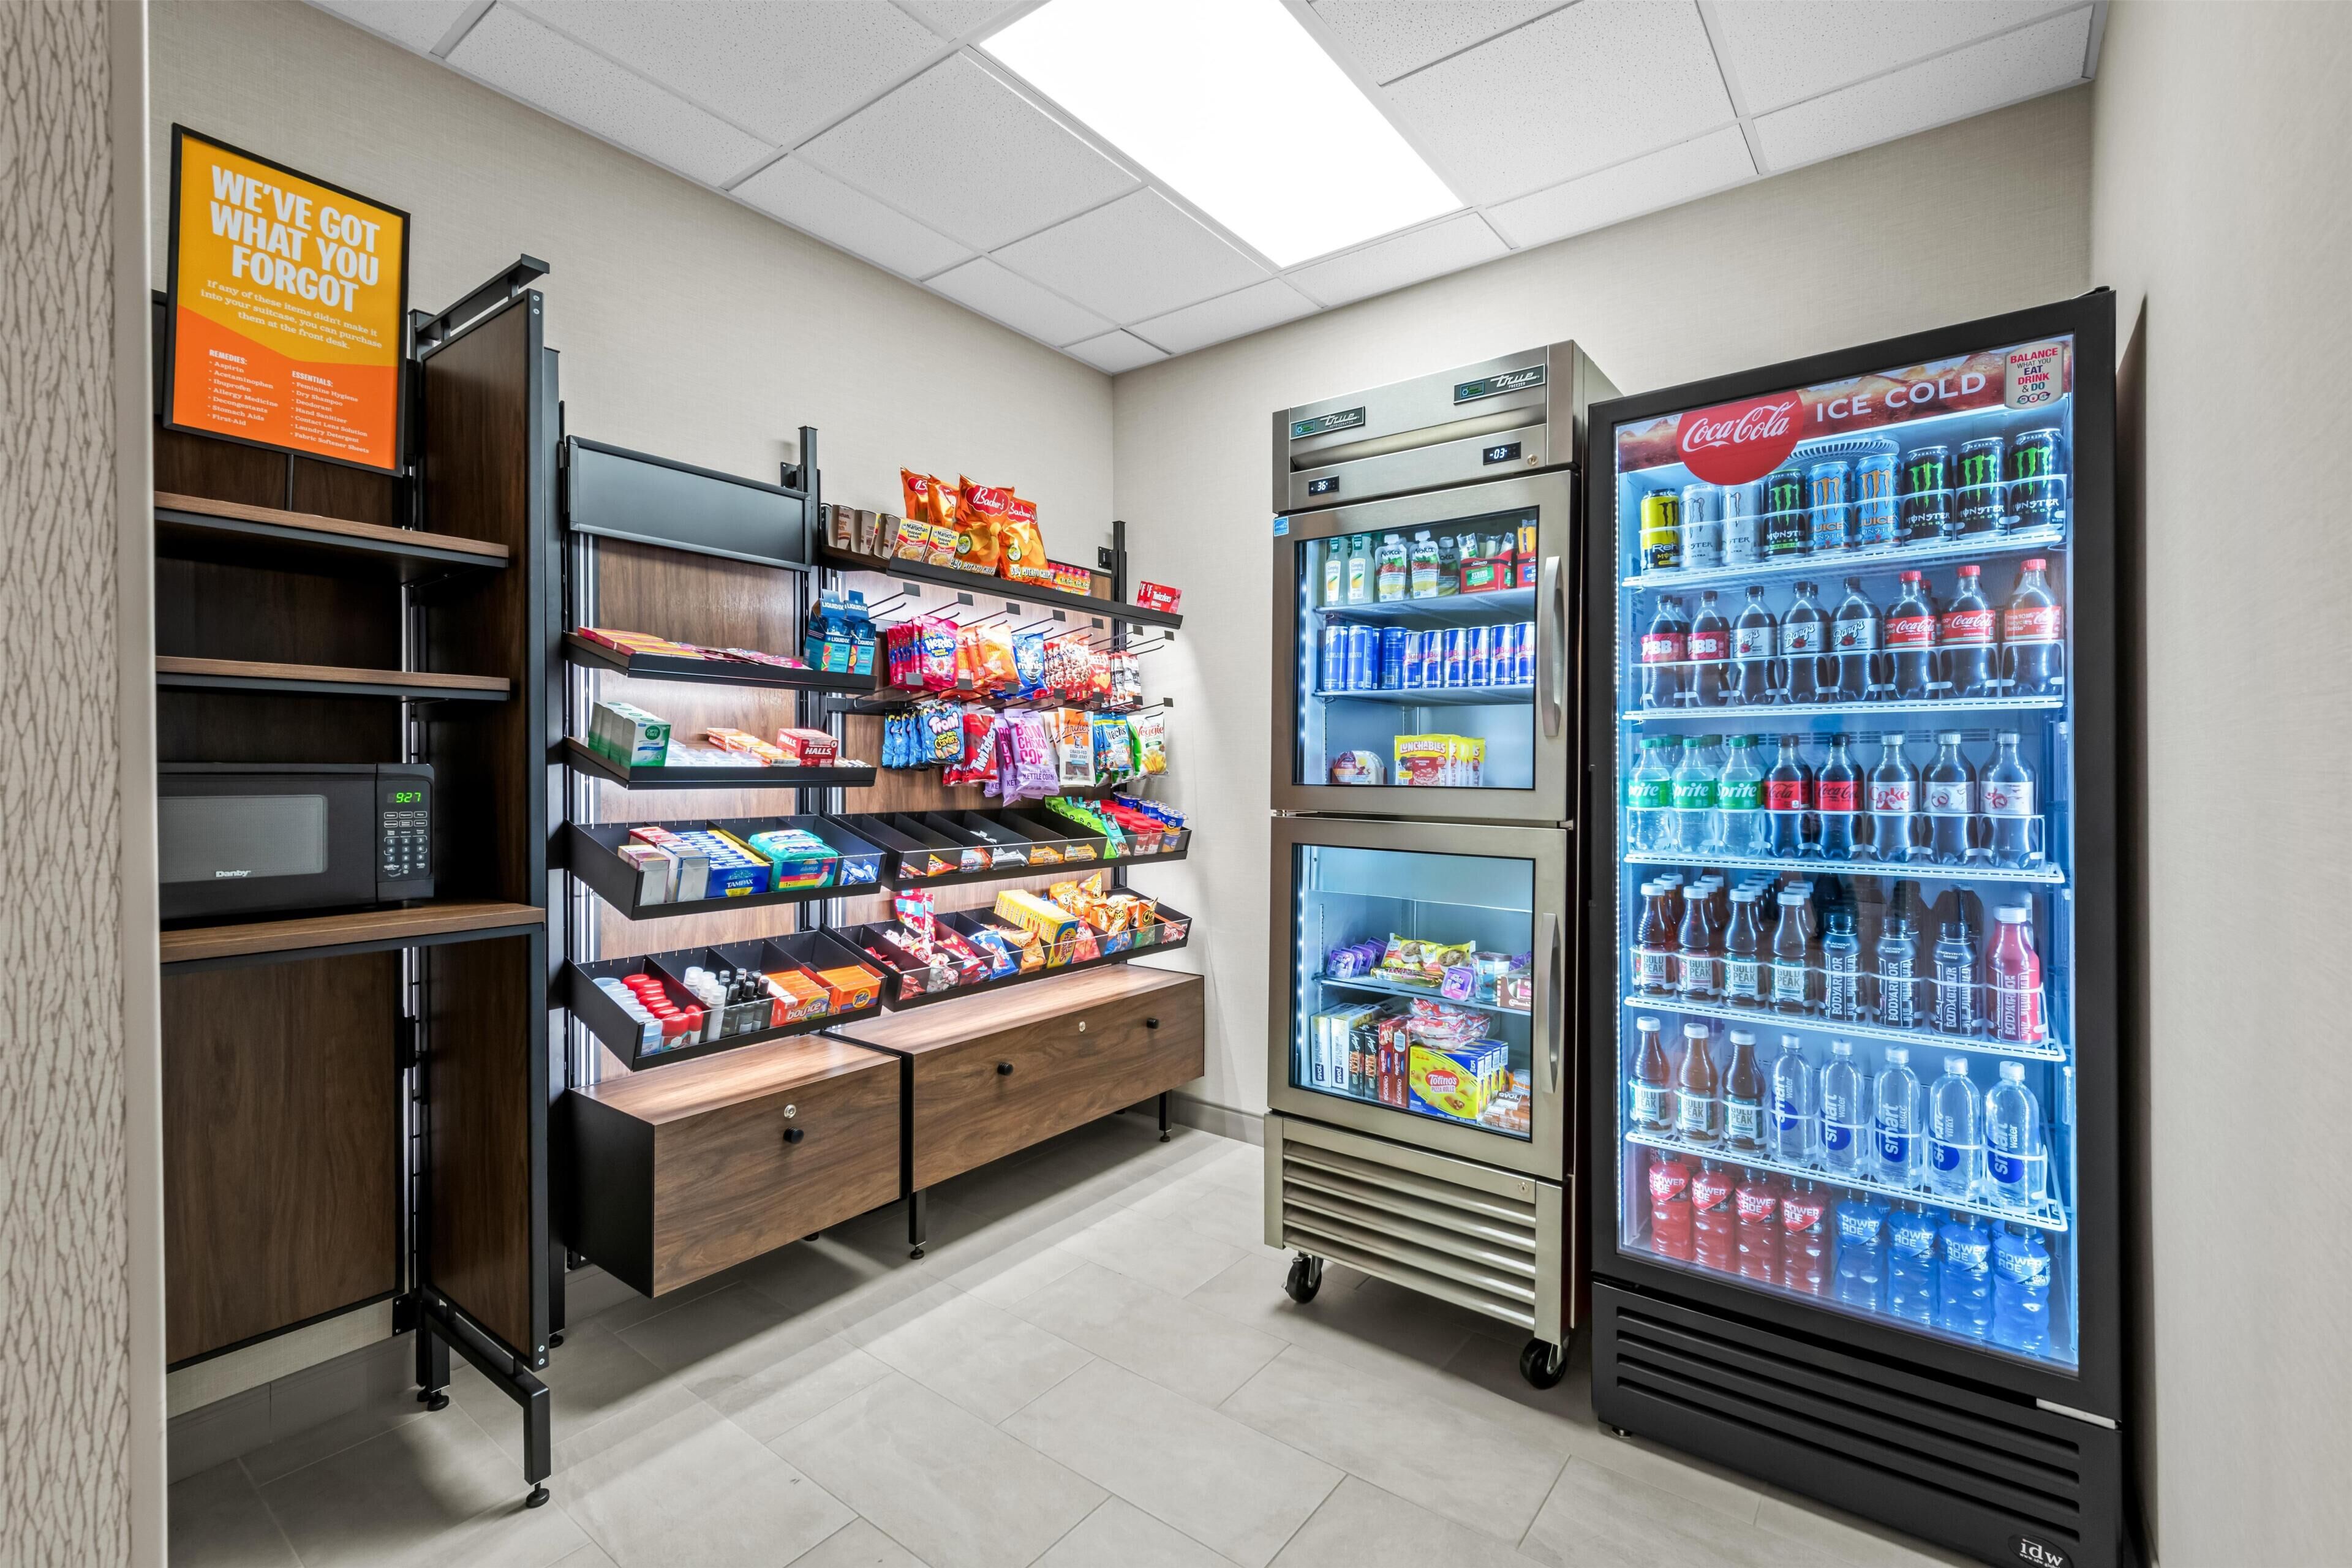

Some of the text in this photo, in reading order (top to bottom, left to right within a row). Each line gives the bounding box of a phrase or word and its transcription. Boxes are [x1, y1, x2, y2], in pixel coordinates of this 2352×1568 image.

[212, 165, 380, 253] WE'VE GOT
[210, 201, 379, 286] WHAT YOU
[232, 245, 358, 312] FORGOT
[207, 280, 377, 337] If any of these items didn't make it
[201, 290, 382, 348] into your suitcase, you can purchase
[238, 311, 350, 349] them at the front desk.
[209, 349, 247, 365] REMEDIES:
[2010, 348, 2059, 364] BALANCE
[214, 361, 244, 372] Aspirin
[214, 370, 273, 389] Acetaminophen
[214, 379, 251, 392] Ibuprofen
[292, 371, 333, 387] ESSENTIALS:
[1490, 372, 1538, 387] true
[2018, 372, 2050, 385] DRINK
[296, 382, 358, 402] Feminine Hygiene
[2031, 382, 2045, 391] DO
[214, 388, 278, 407] Allergy Medicine
[311, 394, 343, 406] Shampoo
[1817, 372, 1986, 422] ICE COLD
[213, 396, 268, 413] Decongestants
[296, 399, 332, 412] Deodorant
[213, 405, 265, 421] Stomach Aids
[213, 414, 246, 426] First-Aid
[295, 407, 347, 423] Hand Sanitizer
[1320, 412, 1359, 426] true
[295, 415, 322, 426] Contact
[341, 426, 368, 437] Solution
[1683, 401, 1798, 453] Coca-Cola
[295, 424, 359, 443] Laundry Detergent
[295, 432, 369, 454] Fabric Softener Sheets
[1317, 481, 1326, 490] 36
[973, 488, 1005, 510] Backer's
[1906, 512, 1950, 523] MONSTER
[907, 524, 928, 533] Maruchan
[1011, 567, 1039, 578] BBQ POTATO
[1896, 619, 1934, 633] Coca-Cola
[1951, 614, 1993, 628] Coca-Cola
[1784, 624, 1815, 648] Barq's
[1833, 620, 1864, 646] Barq's
[925, 637, 954, 651] Nerds
[929, 712, 960, 734] Trolli
[1063, 720, 1090, 737] Archer
[1134, 725, 1164, 737] Veggie
[779, 734, 796, 747] HALLS
[934, 735, 959, 749] Crawlers
[1400, 741, 1446, 754] LUNCHABLES
[1020, 750, 1043, 765] POP
[1717, 783, 1757, 797] Sprite
[1869, 787, 1910, 802] Coke
[726, 879, 753, 888] TAMPAX
[1643, 956, 1664, 964] GOLD
[1643, 964, 1664, 973] PEAK
[1689, 968, 1711, 977] PEAK
[1733, 973, 1755, 982] PEAK
[1777, 977, 1800, 987] PEAK
[854, 993, 869, 1005] Tide
[787, 1001, 822, 1021] bounce
[1470, 1060, 1476, 1069] 15
[1428, 1074, 1458, 1085] Totino's
[1838, 1096, 1846, 1118] water
[1731, 1115, 1753, 1125] PEAK
[2009, 1124, 2018, 1148] water
[1654, 1175, 1685, 1186] POWER
[1694, 1183, 1726, 1196] POWER
[1742, 1203, 1763, 1213] ADE
[1743, 1195, 1776, 1207] POWER
[1784, 1201, 1820, 1217] POWER
[1784, 1210, 1803, 1223] ADE
[1842, 1215, 1880, 1229] POWER
[1842, 1223, 1864, 1236] ADE
[1894, 1235, 1917, 1248] ADE
[1946, 1238, 1988, 1255] POWER
[1947, 1246, 1969, 1262] ADE
[1998, 1251, 2043, 1270] POWER
[1998, 1259, 2022, 1273] ADE
[2021, 1539, 2064, 1566] idw
